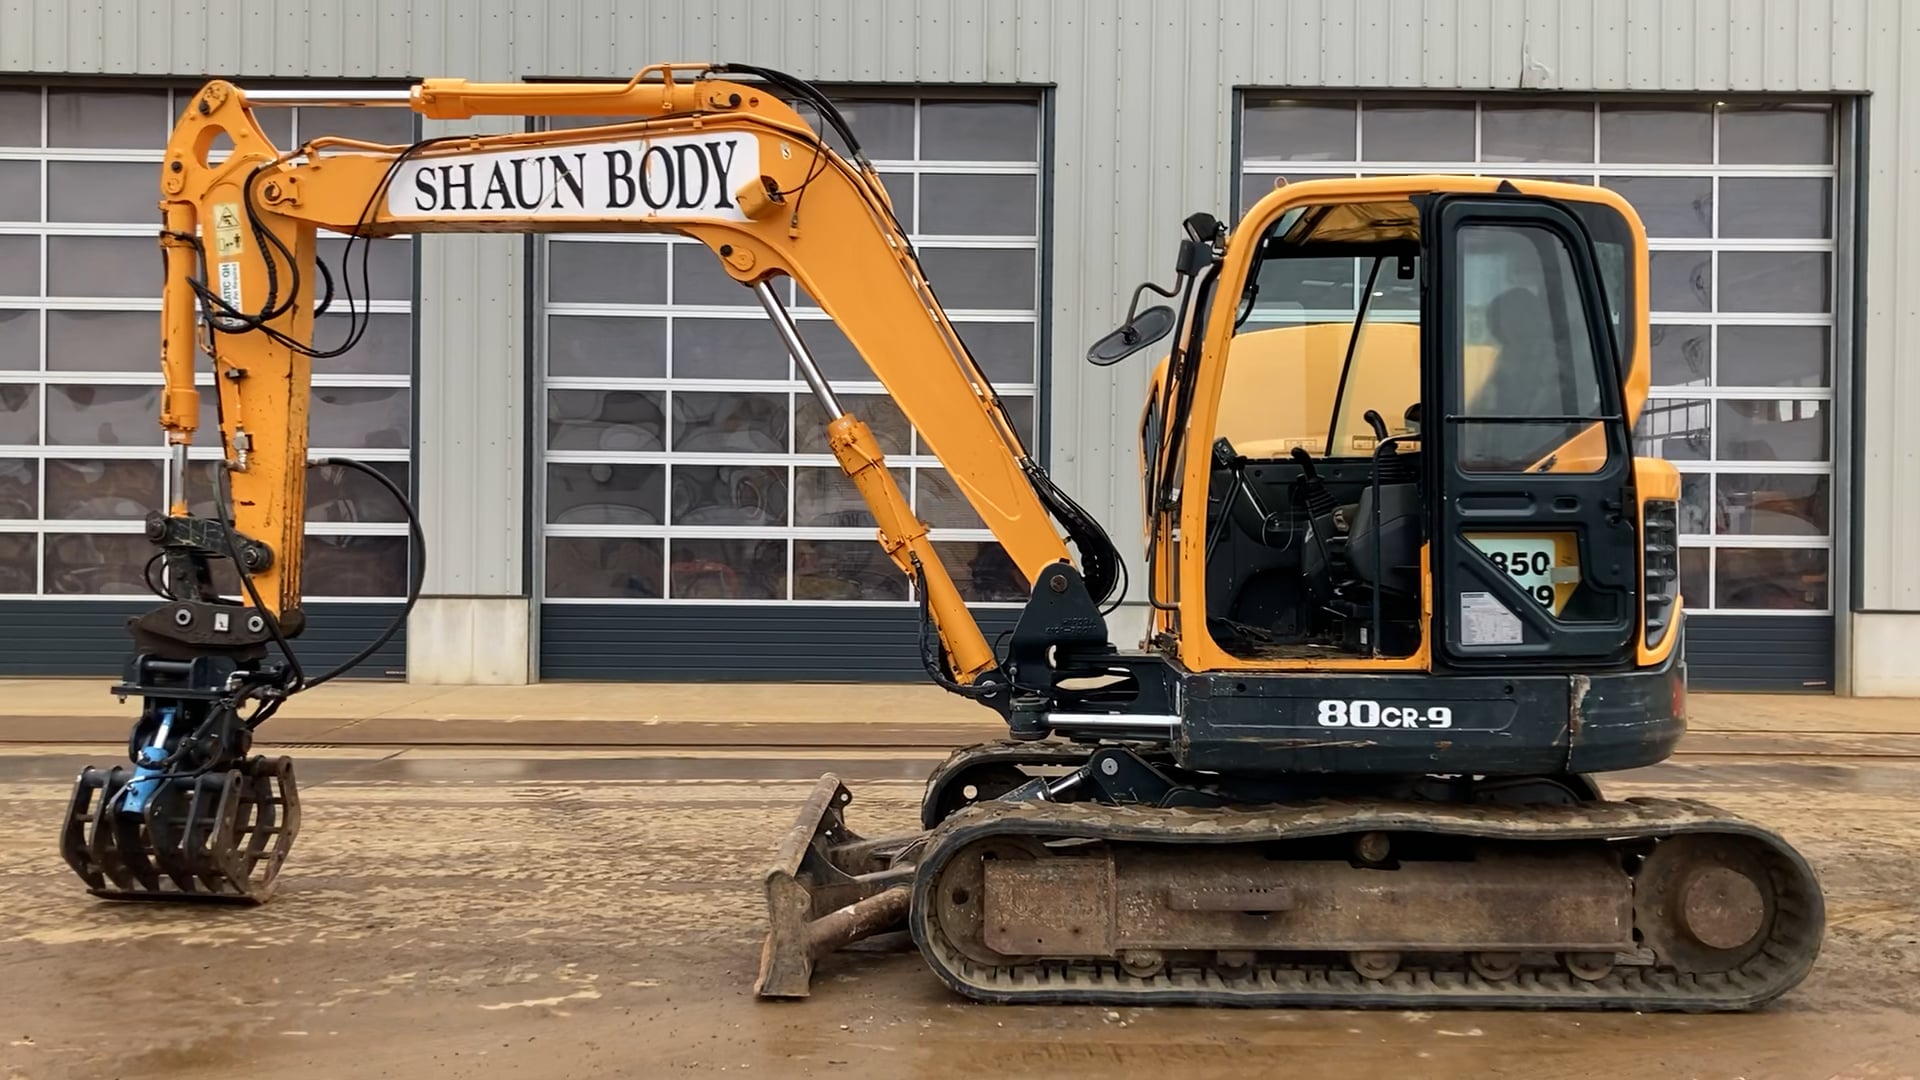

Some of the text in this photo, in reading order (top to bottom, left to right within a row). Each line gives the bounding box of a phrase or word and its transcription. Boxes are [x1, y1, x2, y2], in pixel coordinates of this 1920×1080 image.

[414, 140, 738, 212] SHAUN BODY
[1484, 551, 1551, 576] 850
[1317, 700, 1452, 728] 80CR-9
